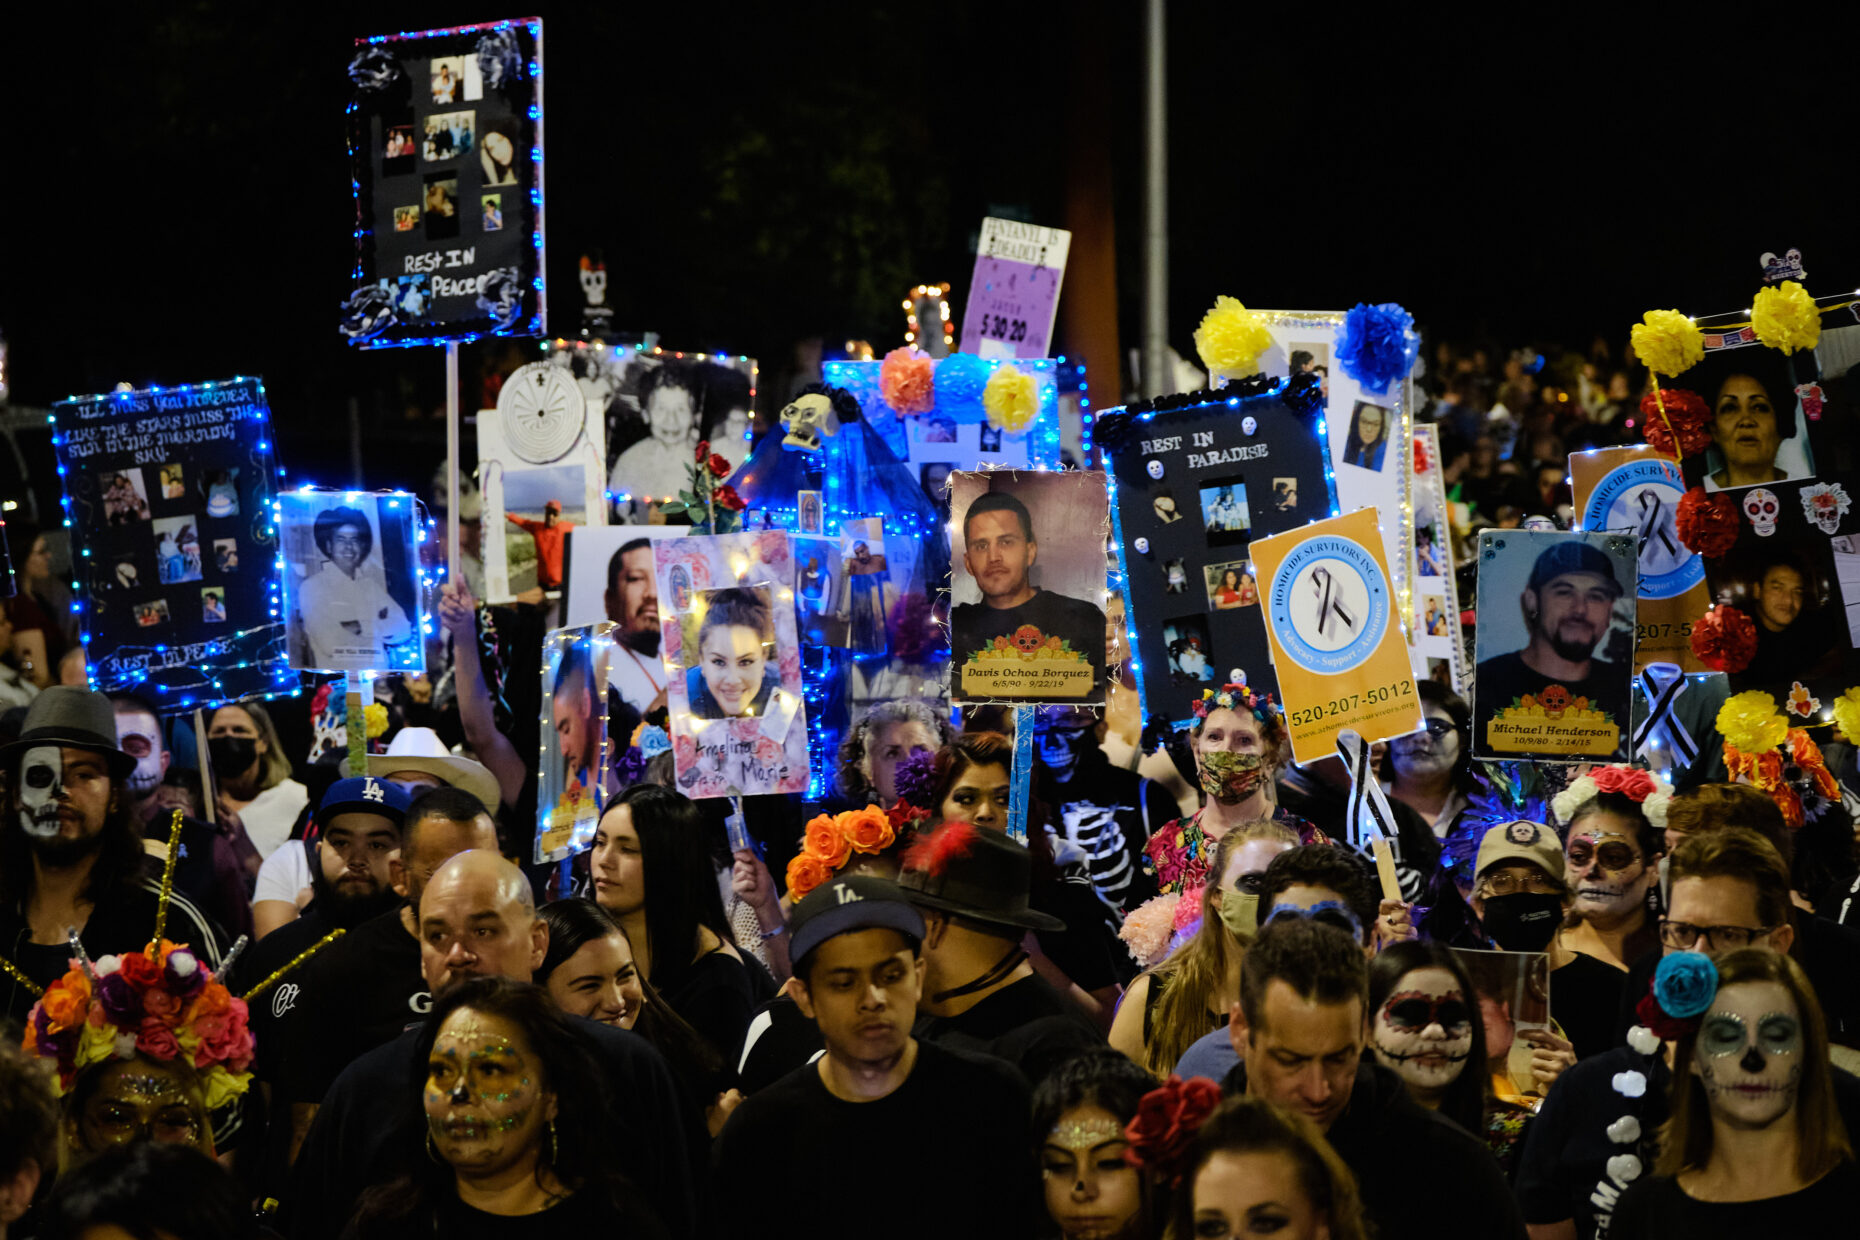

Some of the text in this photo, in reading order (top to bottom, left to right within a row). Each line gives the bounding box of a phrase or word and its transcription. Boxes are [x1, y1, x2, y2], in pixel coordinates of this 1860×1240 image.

[444, 246, 475, 267] IN
[64, 429, 100, 444] LIKE
[101, 423, 131, 438] THE
[136, 416, 181, 432] STARS
[183, 410, 224, 426] MISS
[68, 443, 101, 458] SUN
[157, 423, 236, 446] MORNING
[1140, 431, 1214, 455] REST IN
[1187, 443, 1269, 468] PARADISE
[1591, 470, 1633, 519] HOMICIDE
[1275, 542, 1377, 606] HOMICIDE SURVIVORS INC.
[1283, 628, 1314, 664] Advocacy
[1321, 651, 1357, 668] Support
[1361, 601, 1383, 648] Assistance
[968, 668, 1090, 680] Davis Ochoa Borquez
[992, 680, 1021, 688] 6/5/90
[1029, 680, 1064, 688] 9/22/19
[1291, 680, 1412, 727] 520-207-5012
[1493, 723, 1611, 737] Michael Henderson
[1513, 737, 1548, 745] 10/9/80
[1556, 738, 1591, 746] 2/14/15
[362, 777, 385, 803] LA
